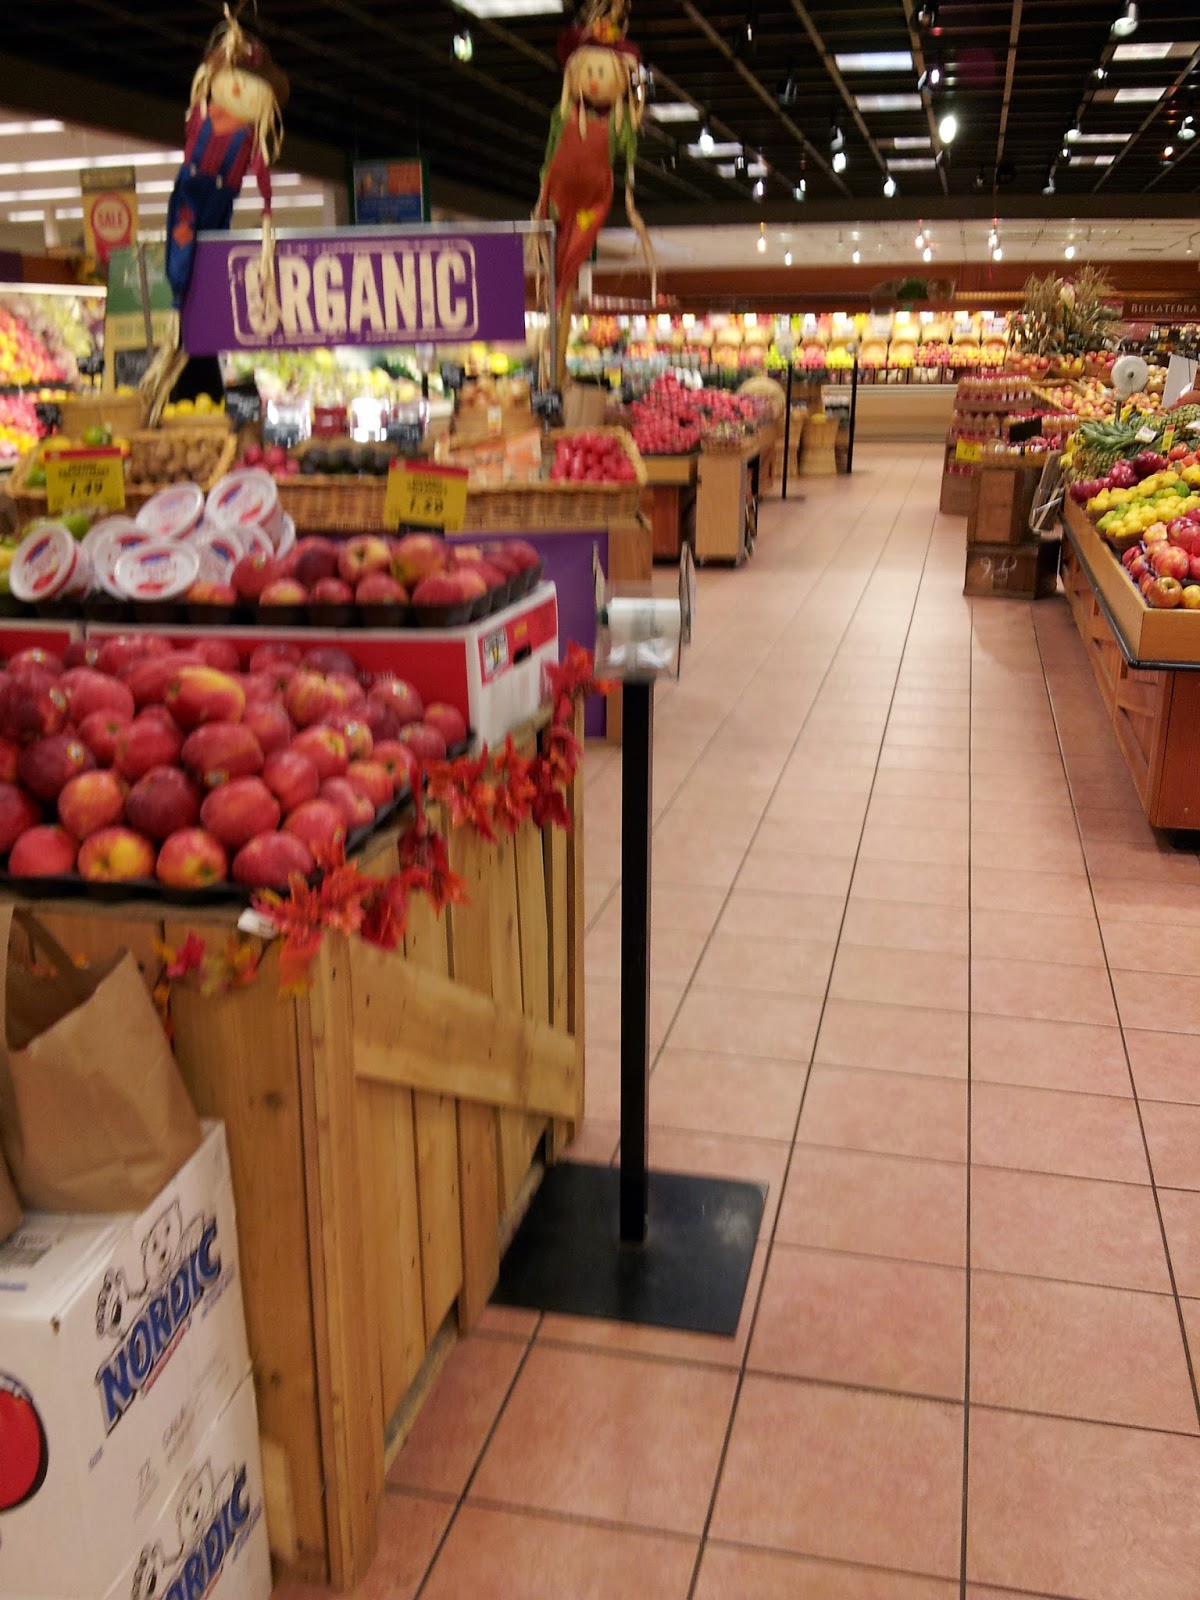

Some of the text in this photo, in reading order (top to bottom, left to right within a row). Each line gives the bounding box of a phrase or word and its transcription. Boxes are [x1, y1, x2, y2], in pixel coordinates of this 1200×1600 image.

[243, 247, 468, 337] ORGANIC
[99, 1222, 219, 1430] NORDIC
[164, 1461, 250, 1600] RDIC
